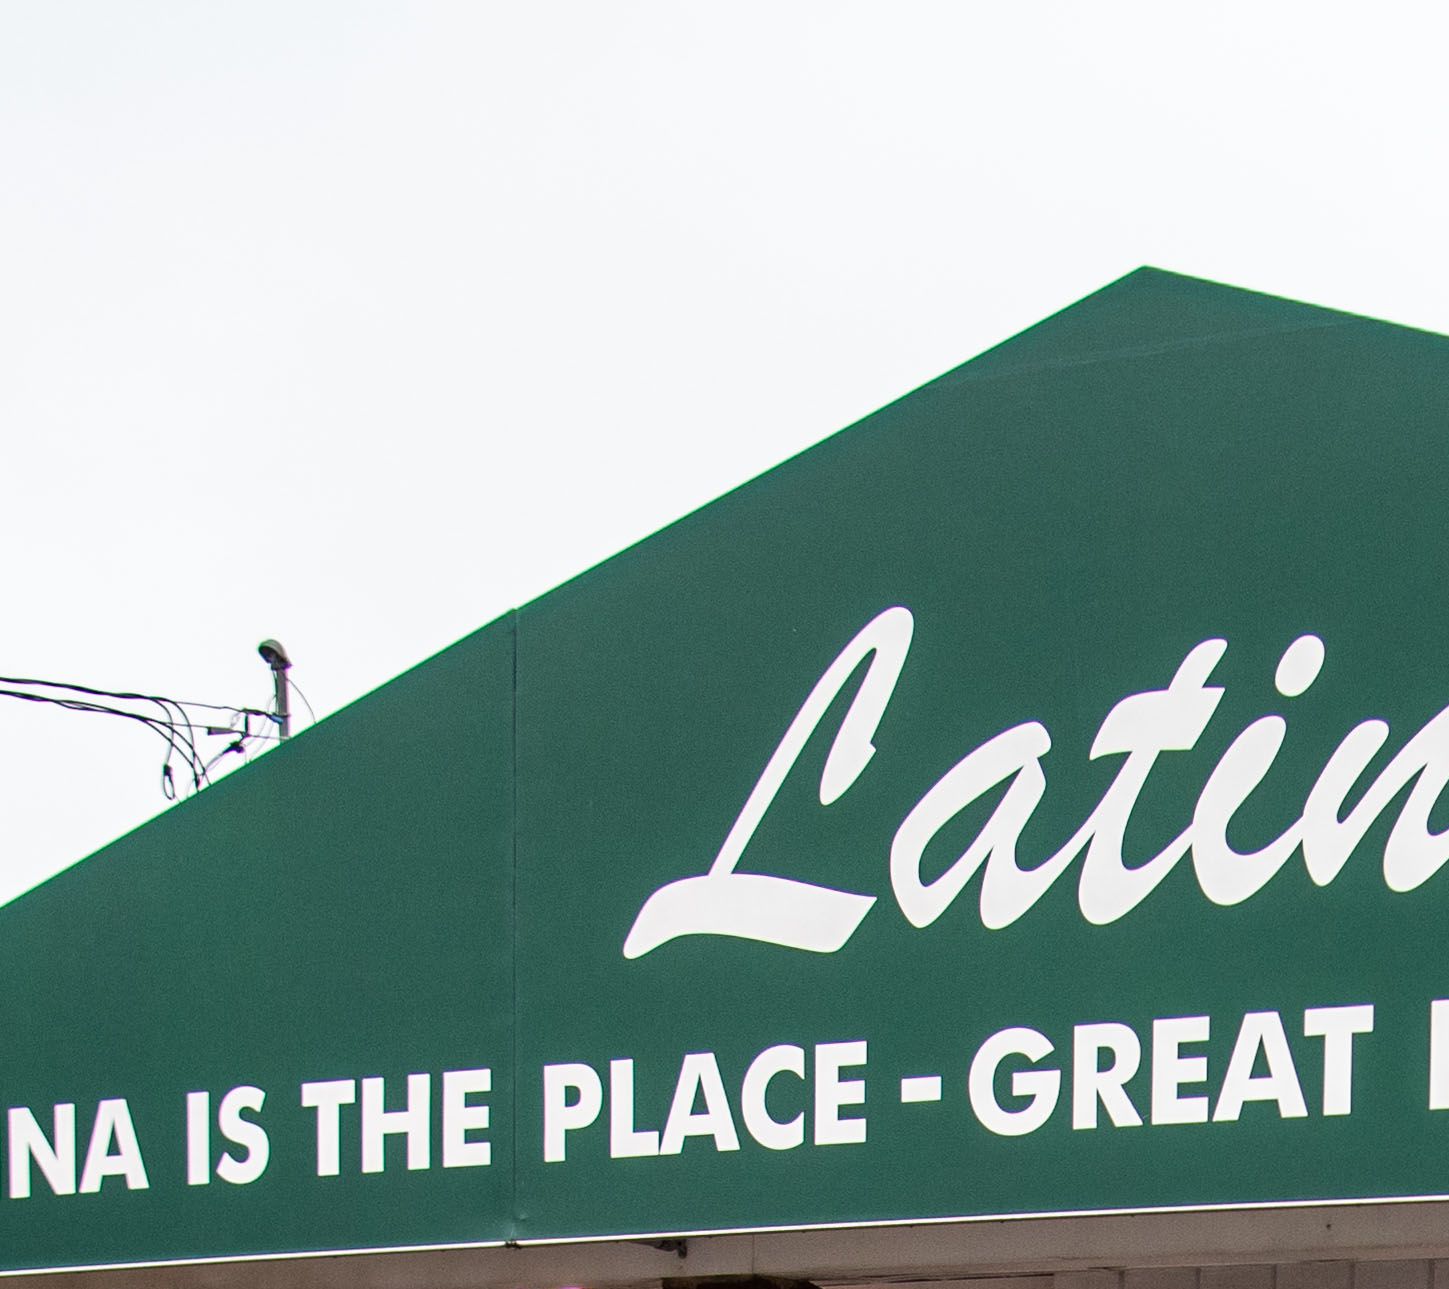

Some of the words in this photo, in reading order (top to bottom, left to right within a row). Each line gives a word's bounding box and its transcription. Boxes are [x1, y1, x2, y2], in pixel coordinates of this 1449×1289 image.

[188, 1086, 268, 1186] IS
[302, 1069, 490, 1177] THE
[544, 1041, 866, 1162] PLACE
[969, 1005, 1373, 1135] GREAT
